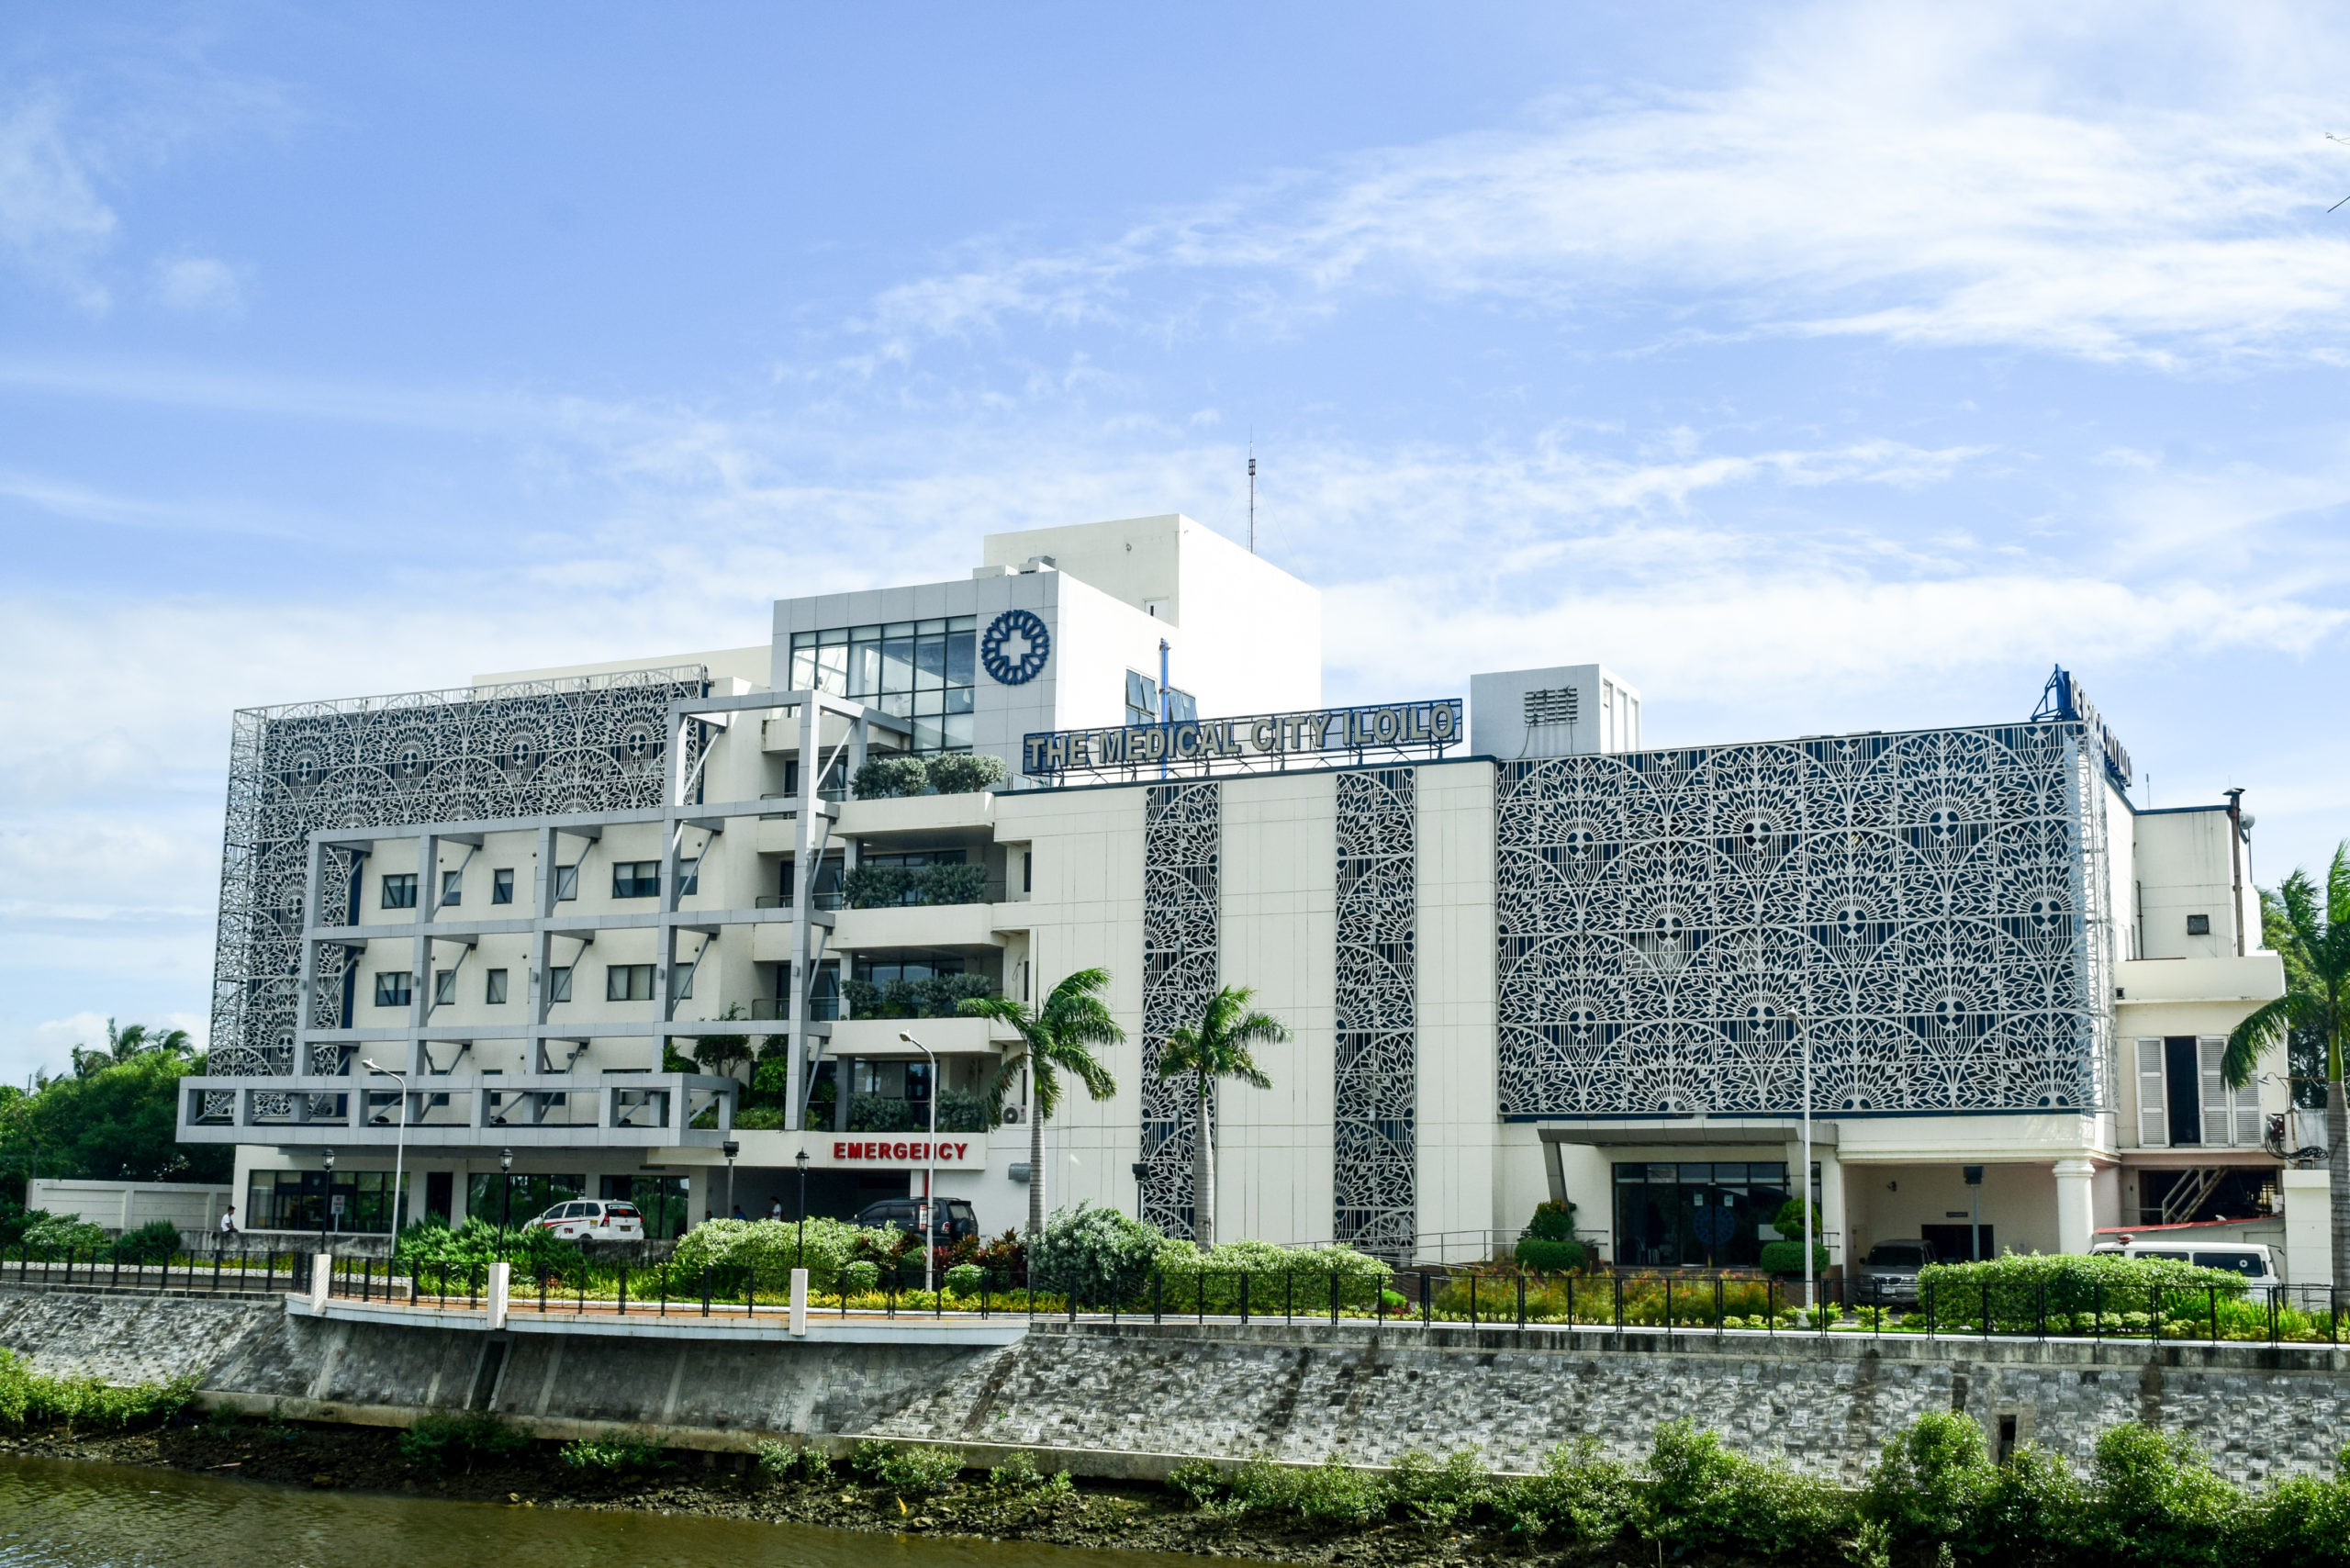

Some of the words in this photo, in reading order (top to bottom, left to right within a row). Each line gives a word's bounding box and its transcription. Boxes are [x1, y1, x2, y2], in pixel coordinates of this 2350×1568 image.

[1026, 734, 1089, 767] THE
[1099, 722, 1242, 764] MEDICAL
[1251, 714, 1331, 751] CITY
[1342, 704, 1456, 745] ILOILO
[833, 1141, 968, 1160] EMERGENCY
